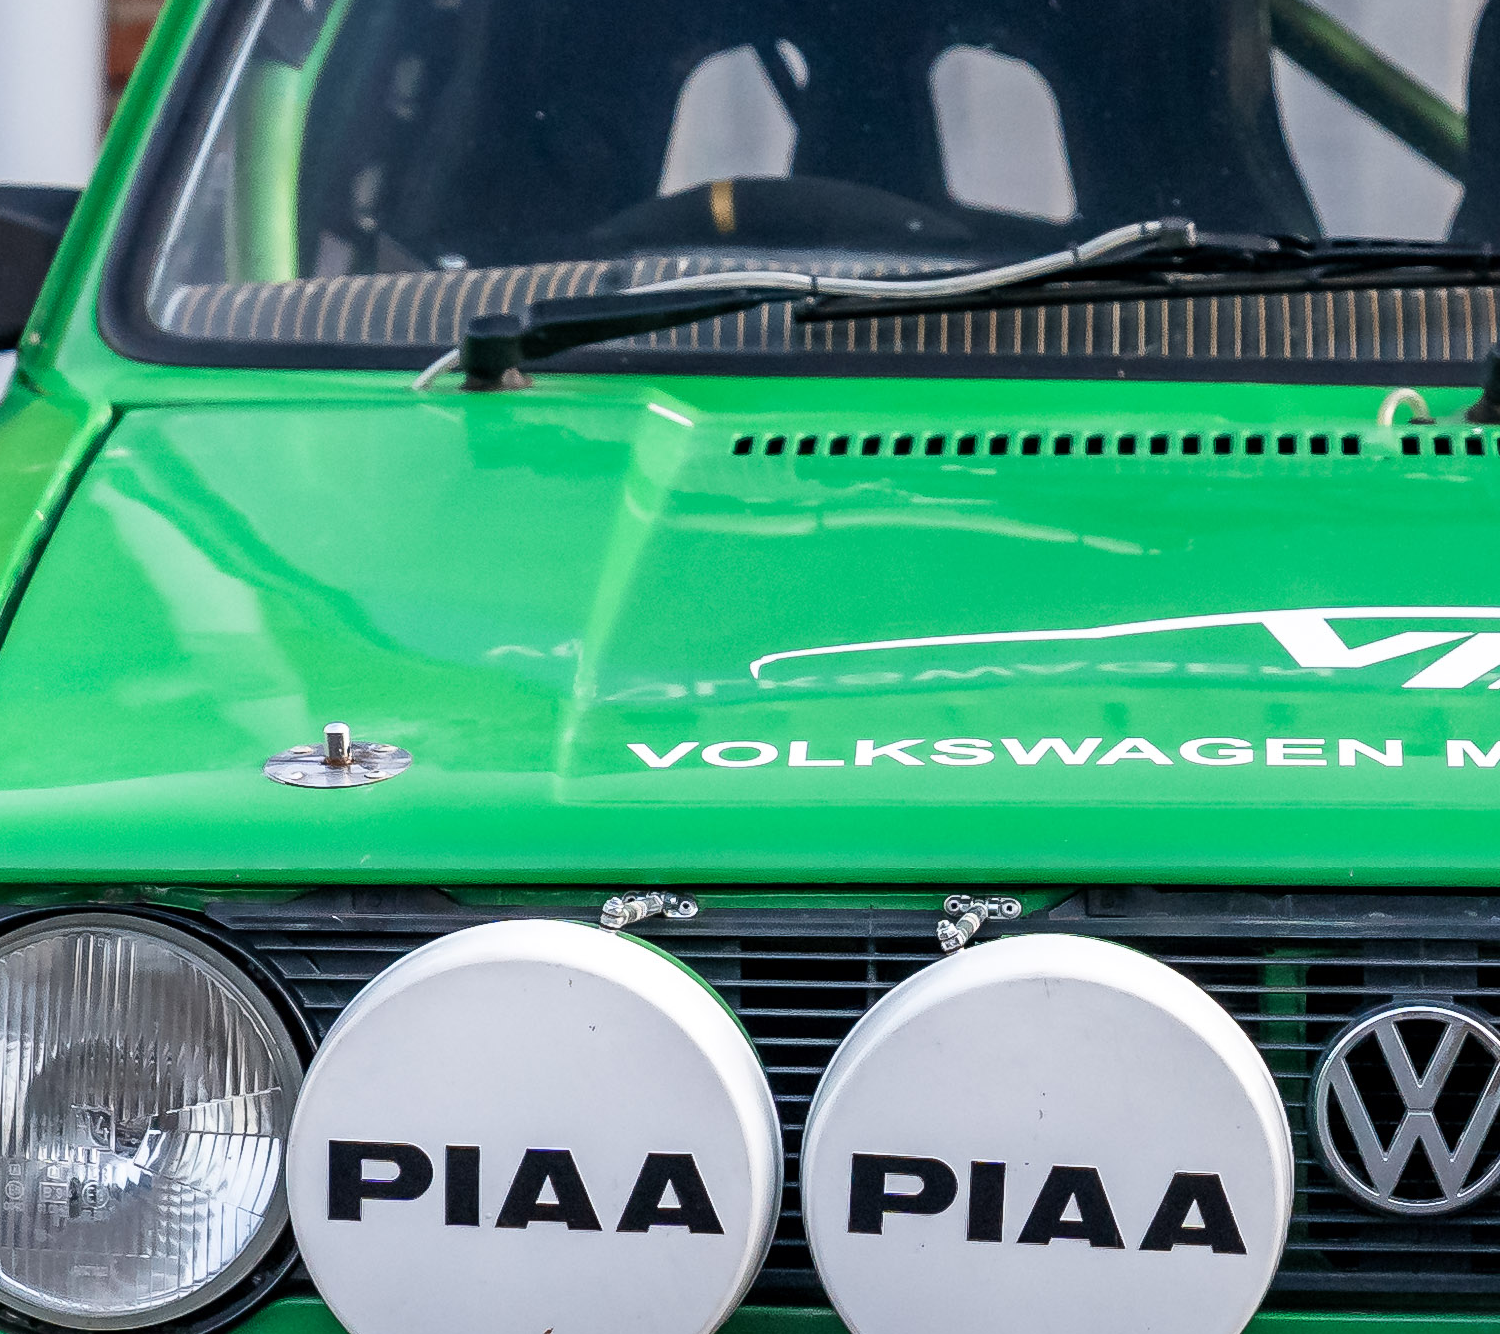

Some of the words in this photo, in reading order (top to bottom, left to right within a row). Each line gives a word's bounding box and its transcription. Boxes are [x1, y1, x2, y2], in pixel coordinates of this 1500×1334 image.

[626, 737, 1404, 769] VOLKSWAGEN
[327, 1139, 725, 1235] PIAA
[847, 1152, 1248, 1255] PIAA
